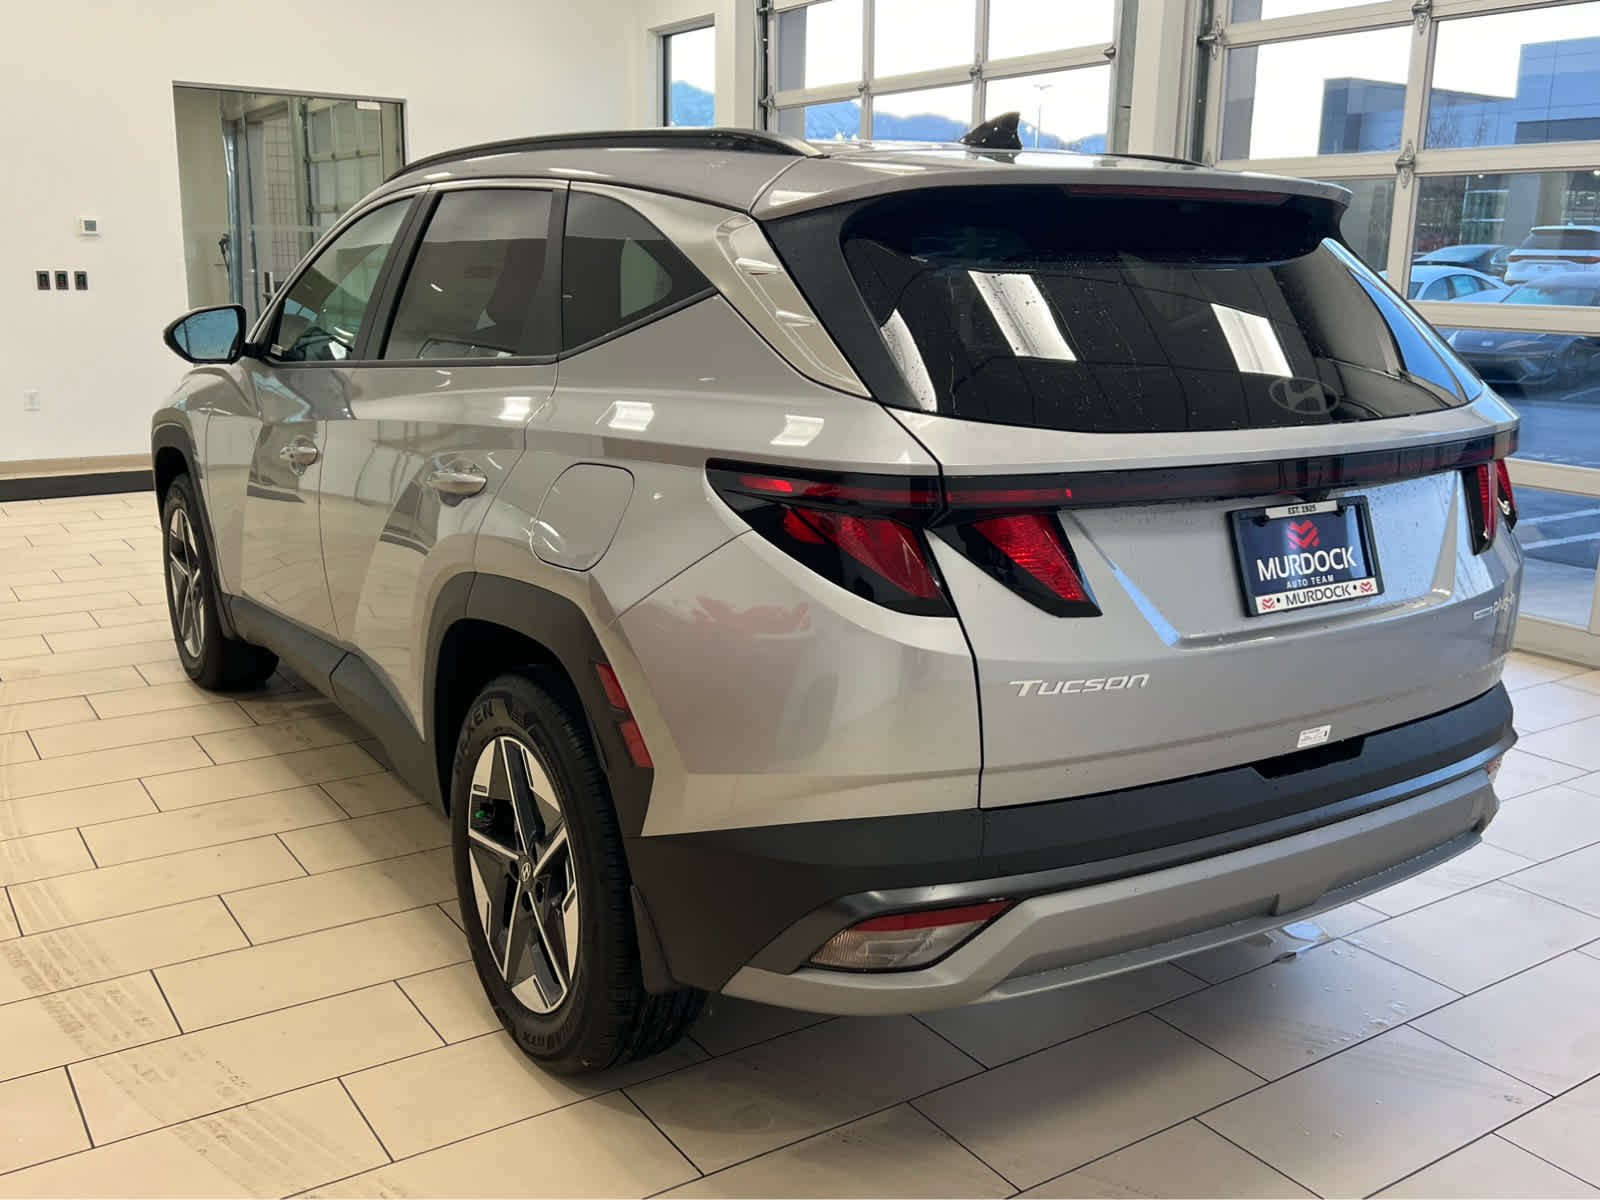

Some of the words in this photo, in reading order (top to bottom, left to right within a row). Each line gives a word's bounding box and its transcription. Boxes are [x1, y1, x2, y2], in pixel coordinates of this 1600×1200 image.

[1256, 546, 1357, 582] MURDOCK
[1286, 578, 1308, 589] AUTO
[1310, 574, 1334, 585] TEAM
[1285, 583, 1351, 607] MURDOCK
